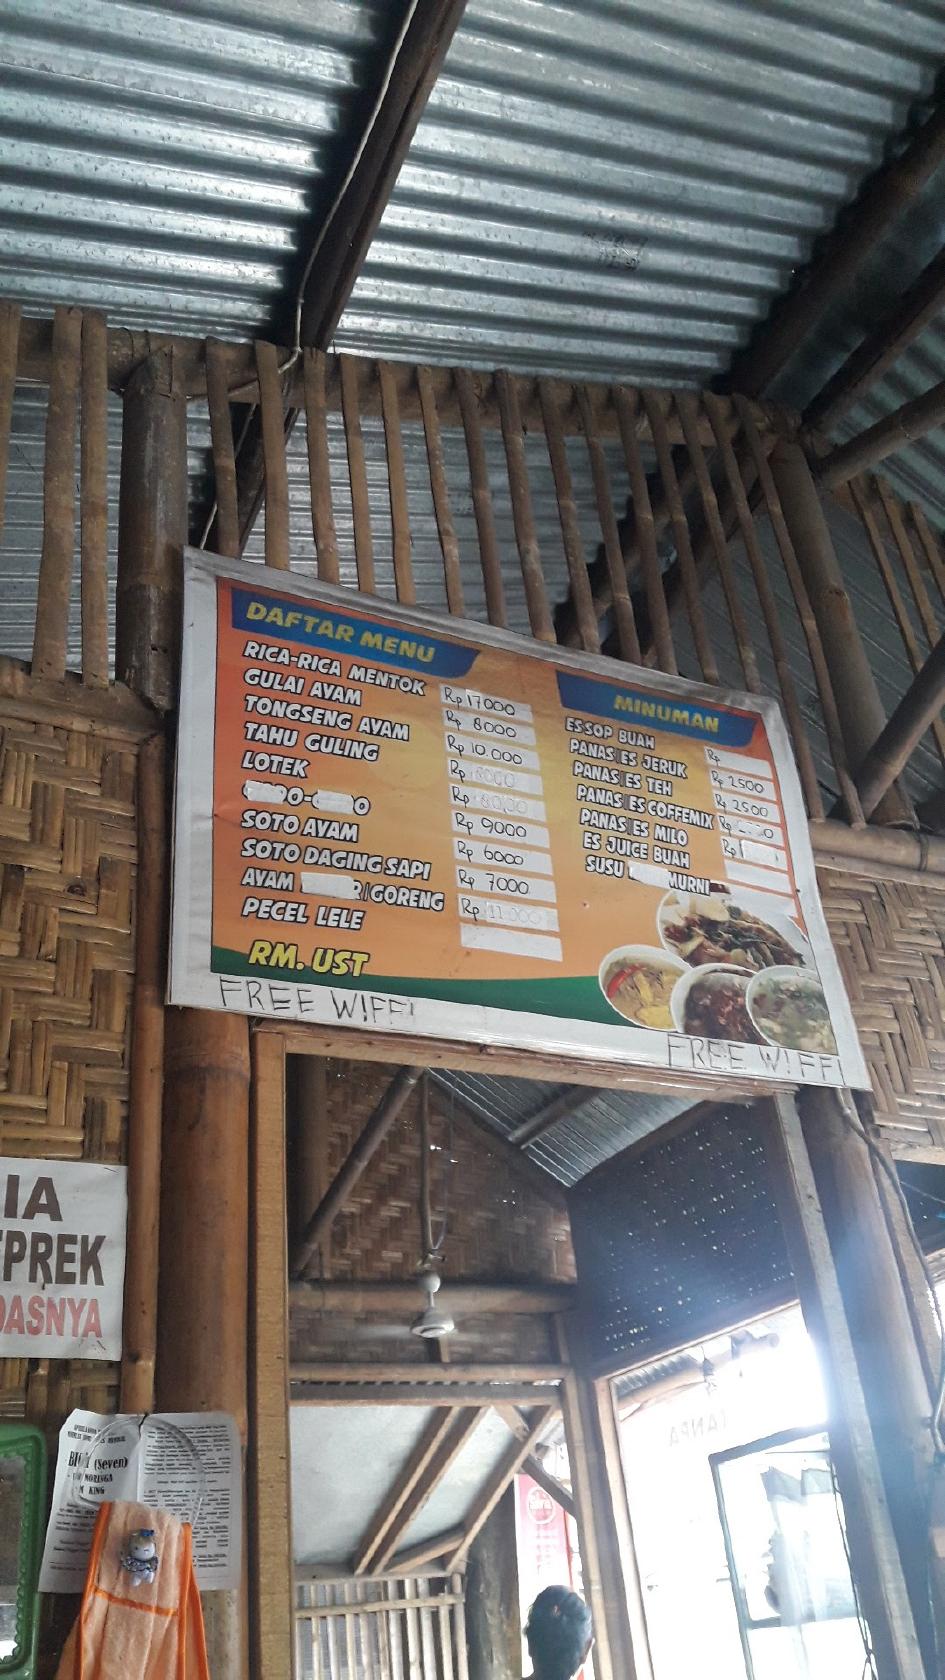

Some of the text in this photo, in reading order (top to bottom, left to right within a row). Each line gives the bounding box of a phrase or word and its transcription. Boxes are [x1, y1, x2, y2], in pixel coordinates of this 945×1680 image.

[246, 602, 436, 663] DAFTAR MENU
[243, 640, 425, 696] RICA-RICA MENTOK
[244, 668, 362, 706] GULAI AYAM
[445, 687, 515, 715] Rp 17000
[245, 695, 409, 741] TONGSENG AYAM
[446, 710, 516, 738] Rp 8000
[613, 695, 719, 733] MINUMAN
[245, 722, 379, 761] TAHU GULING
[448, 735, 464, 757] Rp
[618, 729, 655, 750] BUAH
[241, 751, 310, 778] LOTEK
[451, 760, 466, 783] Rp
[642, 754, 688, 779] JERUK
[452, 786, 469, 808] Rp
[646, 776, 673, 797] TEH
[728, 776, 764, 794] 2500
[646, 800, 715, 830] COFFEMIX
[732, 799, 768, 817] 2500
[241, 809, 359, 842] SOTO AYAM
[455, 812, 527, 838] Rp 9000
[654, 823, 688, 847] MILO
[241, 837, 431, 880] SOTO DAGING SAPI
[457, 841, 524, 865] Rp 6000
[583, 830, 690, 870] ES JUICE BUAH
[241, 867, 294, 891] AYAM
[585, 855, 625, 878] SUSU
[458, 869, 529, 894] Rp 7000
[241, 897, 366, 930] PECEL LELE
[461, 898, 480, 921] Rp
[249, 939, 370, 977] RM. UST
[219, 976, 314, 1013] FREE
[667, 1031, 747, 1070] FREE
[4, 1174, 63, 1221] IA
[0, 1230, 106, 1286] PREK
